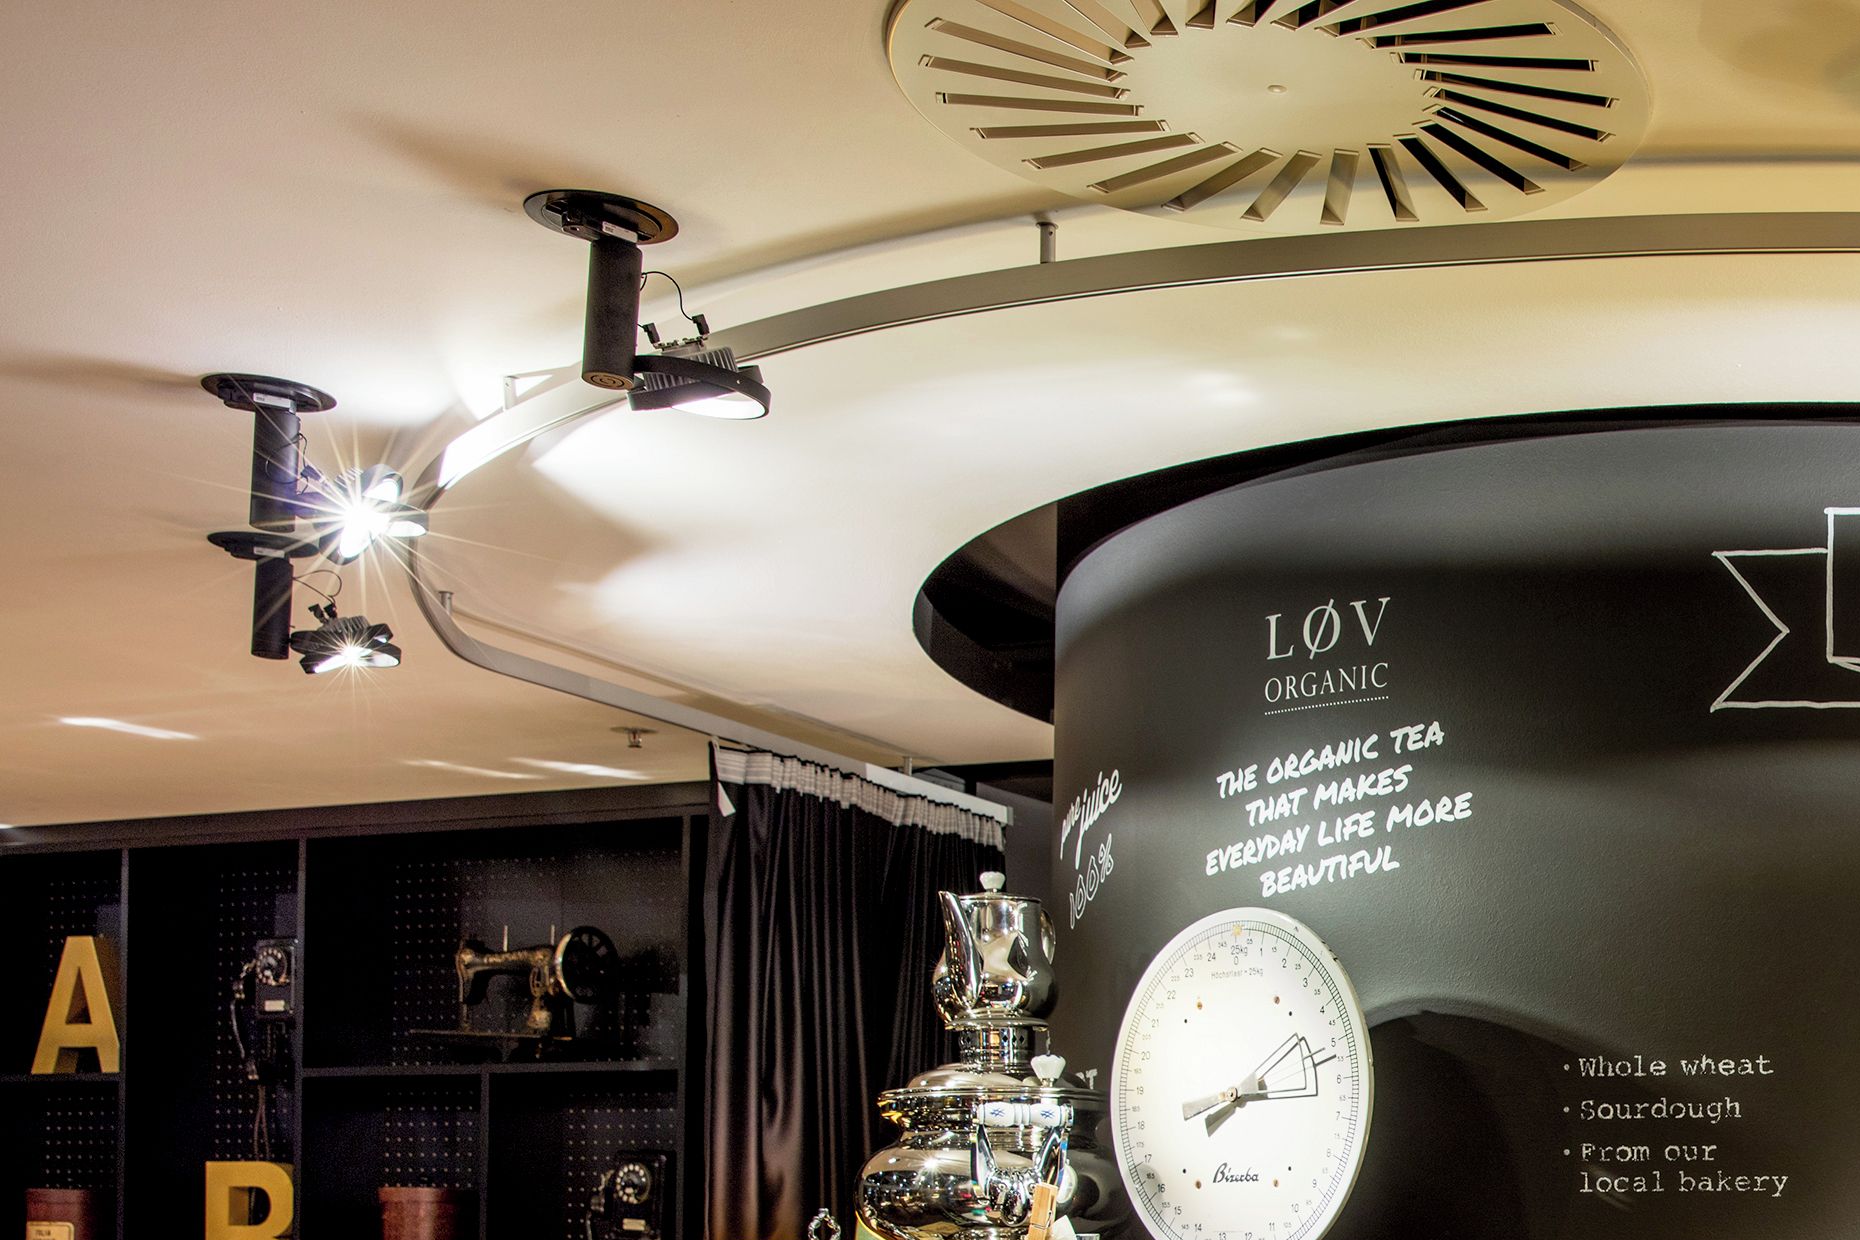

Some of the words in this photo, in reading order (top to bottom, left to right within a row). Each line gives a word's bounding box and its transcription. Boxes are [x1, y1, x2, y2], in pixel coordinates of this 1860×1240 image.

[1264, 661, 1389, 703] ORGANIC
[1217, 765, 1257, 799] THE
[1266, 733, 1379, 785] ORGANIC
[1390, 720, 1445, 753] TEA
[1075, 768, 1123, 871] juice
[1245, 787, 1307, 827] THAT
[1313, 763, 1409, 808] MAKES
[1205, 823, 1311, 876] EVERYDAY
[1318, 811, 1379, 848] LIFE
[1386, 791, 1473, 835] MORE
[1069, 832, 1114, 930] 100%
[1259, 845, 1400, 898] BEAUTIFUL
[30, 935, 120, 1074] A
[1578, 1055, 1667, 1077] Whole
[1680, 1054, 1775, 1077] wheat
[1580, 1097, 1742, 1124] Sourdough
[1581, 1143, 1650, 1162] From
[1664, 1143, 1718, 1162] our
[1579, 1171, 1665, 1193] local
[1678, 1171, 1789, 1198] bakery
